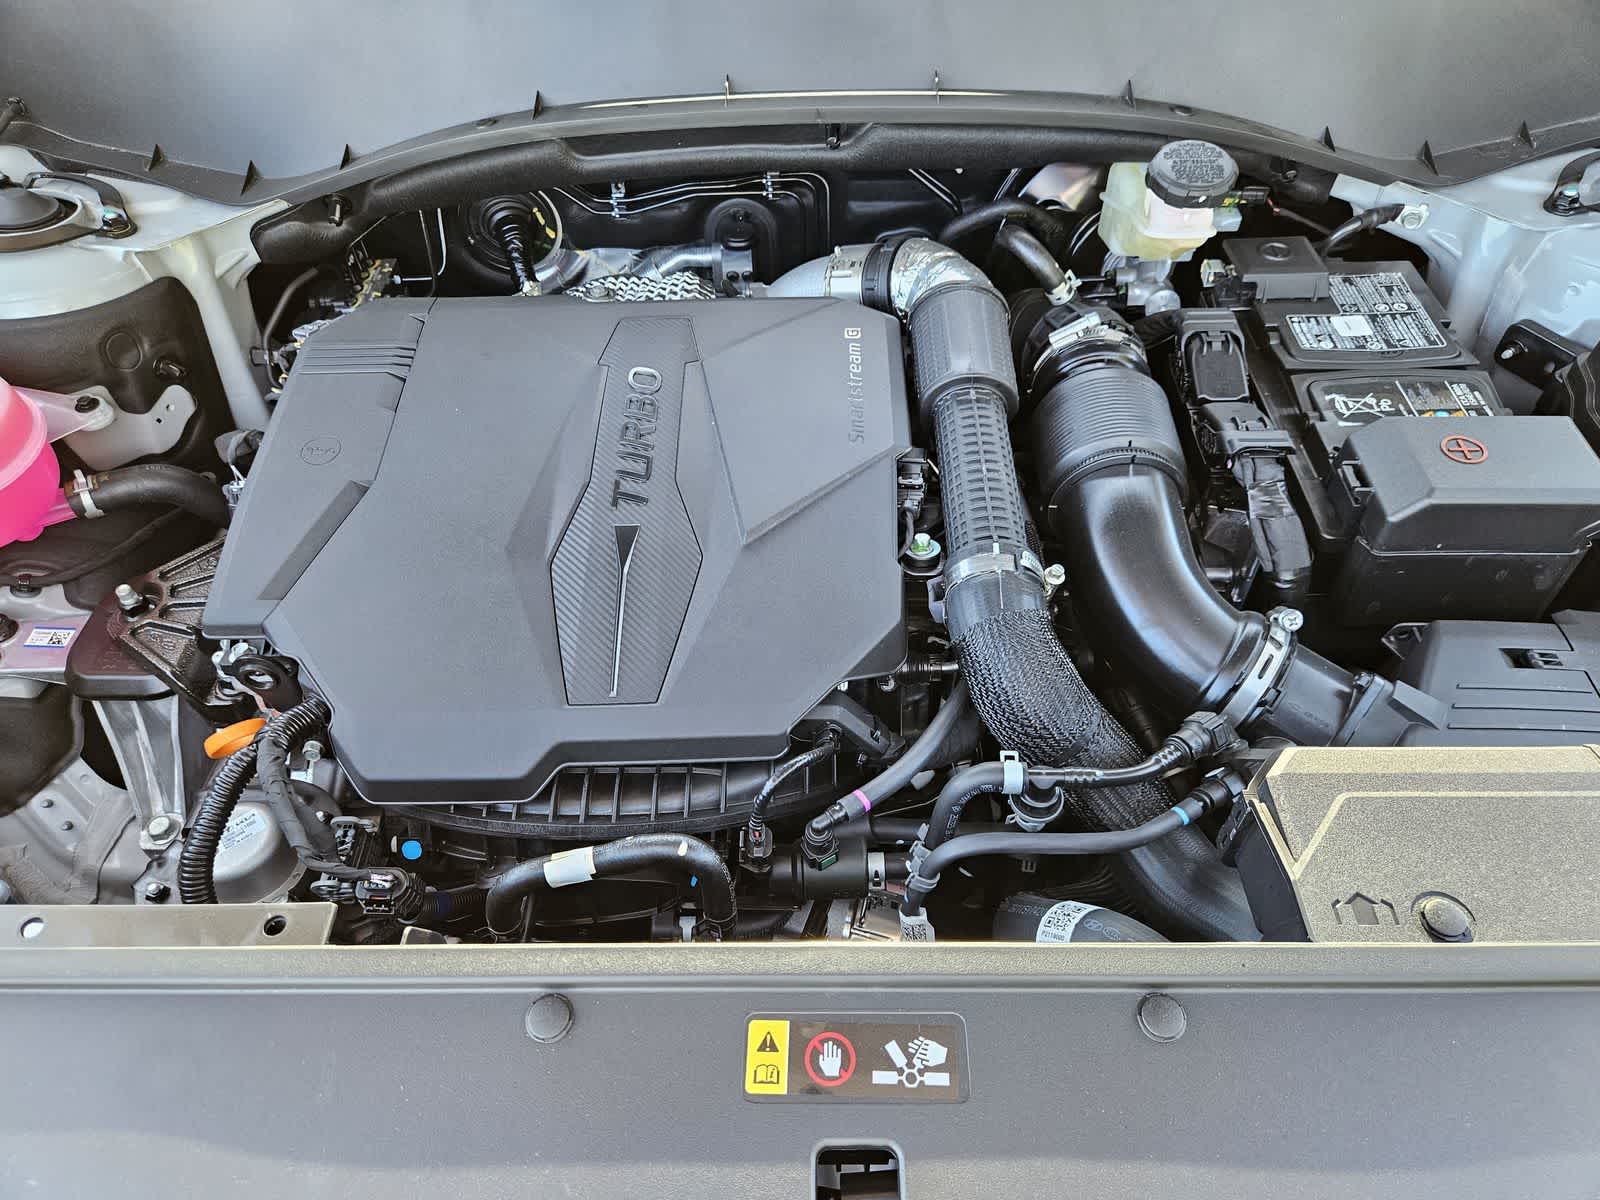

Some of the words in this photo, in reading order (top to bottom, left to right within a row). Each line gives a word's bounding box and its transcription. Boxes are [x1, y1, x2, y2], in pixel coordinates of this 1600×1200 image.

[611, 366, 662, 509] TURBO
[847, 344, 864, 444] Smartstream
[1378, 398, 1395, 411] Pb
